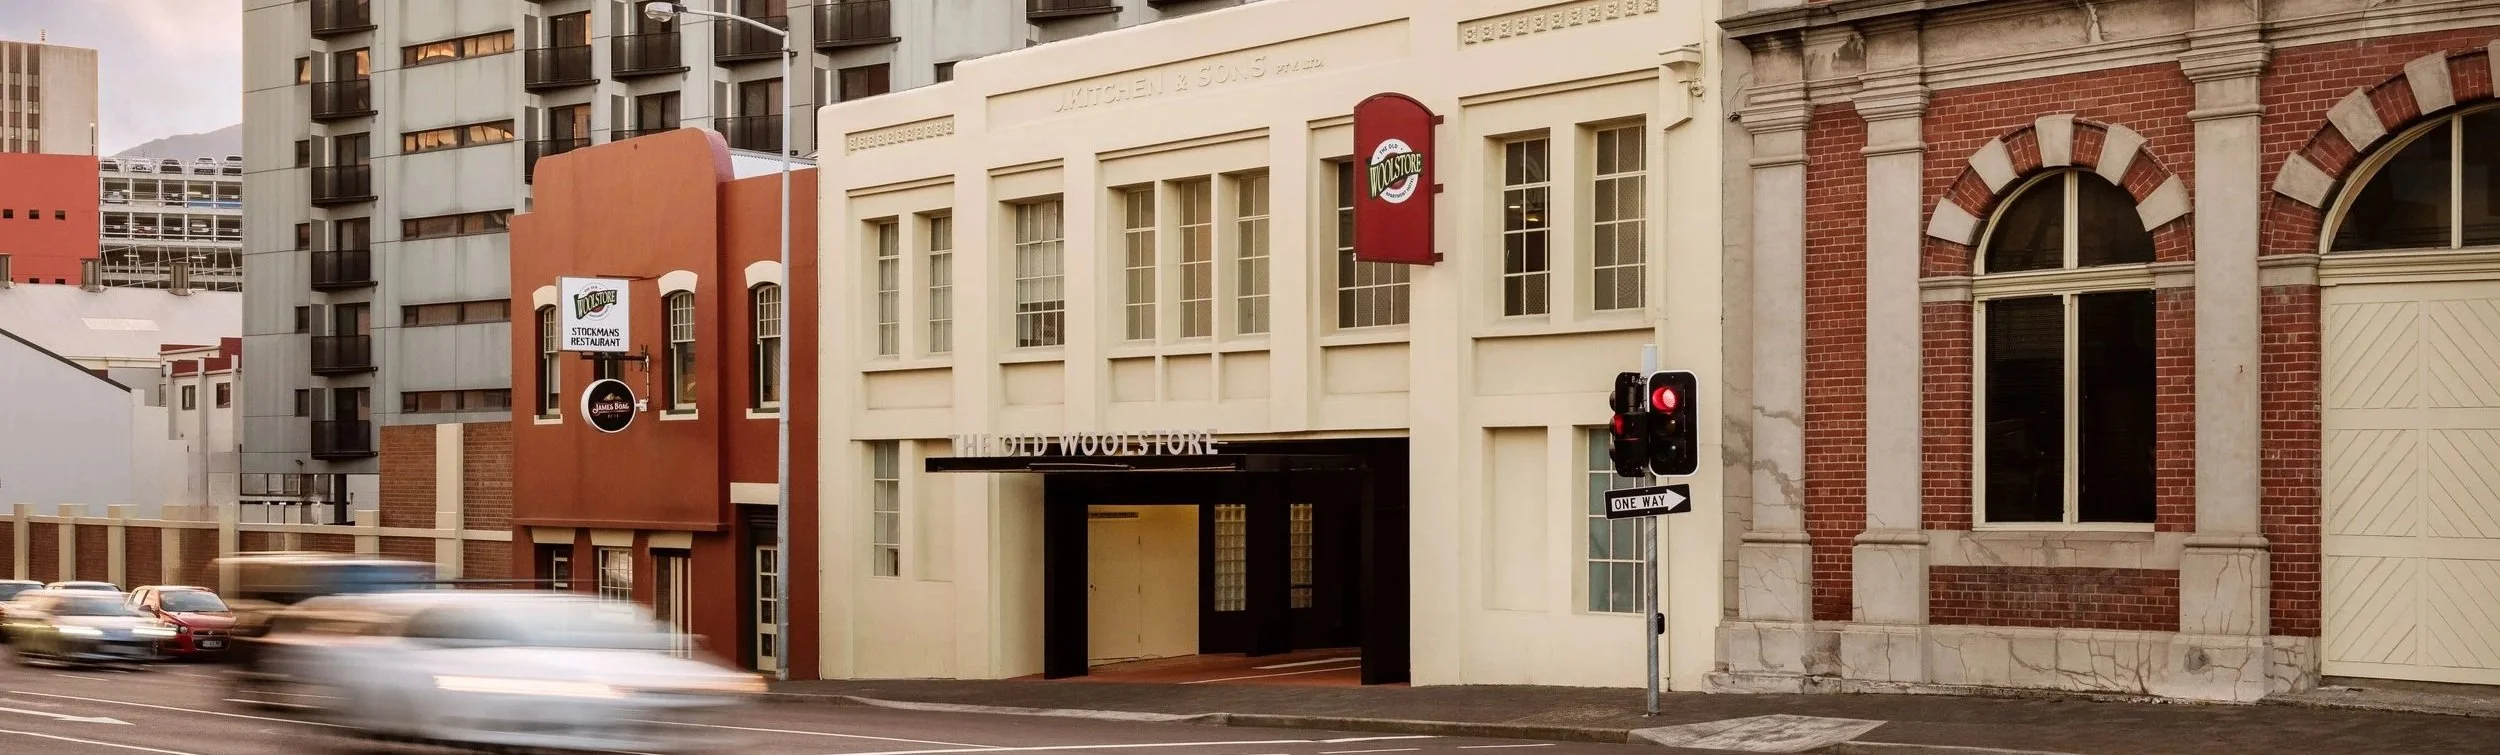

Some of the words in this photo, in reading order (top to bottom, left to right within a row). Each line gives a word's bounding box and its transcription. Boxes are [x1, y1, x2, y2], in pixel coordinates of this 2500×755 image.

[1176, 74, 1188, 92] &
[1199, 56, 1266, 87] SONS
[1370, 153, 1422, 198] WOOLSTORE
[577, 290, 616, 319] WOOLSTORE
[570, 337, 621, 347] RESTAURANT
[571, 327, 620, 337] STOCKMANS
[592, 403, 614, 414] JAMES
[614, 402, 630, 410] BOAG
[948, 433, 992, 457] THE
[1001, 433, 1048, 457] OLD
[1059, 429, 1219, 457] WOOLSTORE
[1614, 497, 1637, 511] ONE
[1642, 494, 1666, 508] WAY
